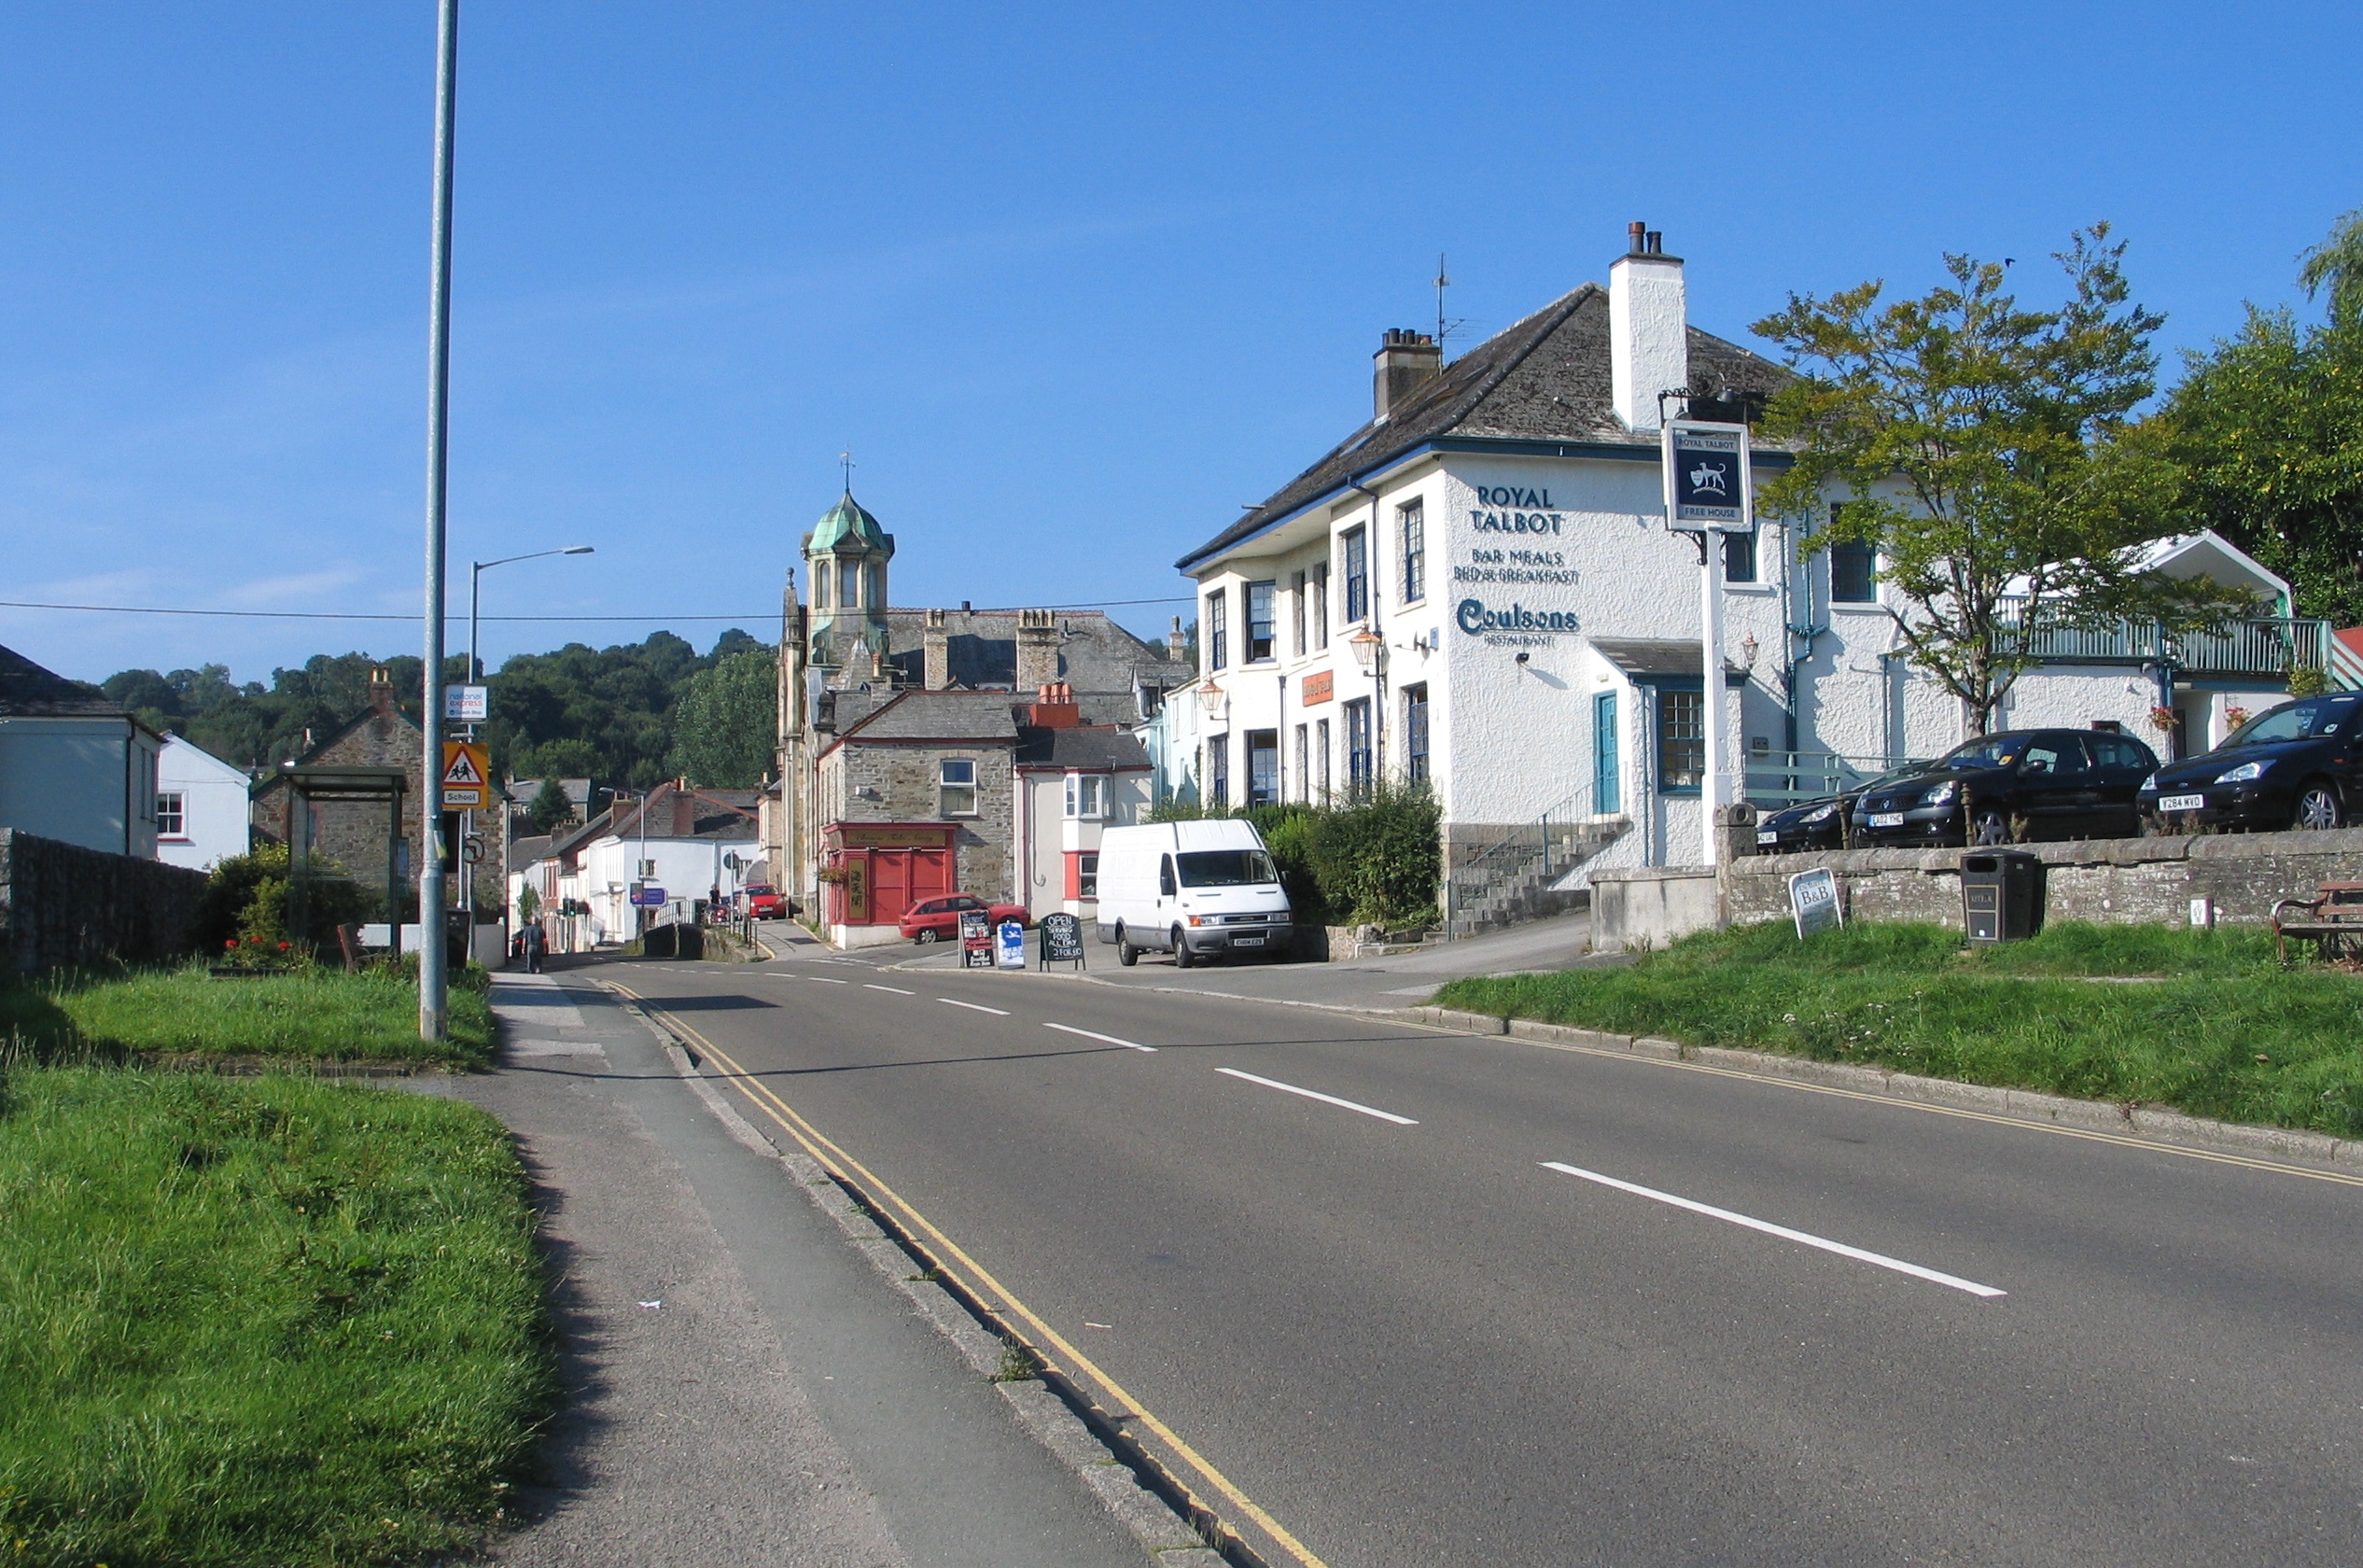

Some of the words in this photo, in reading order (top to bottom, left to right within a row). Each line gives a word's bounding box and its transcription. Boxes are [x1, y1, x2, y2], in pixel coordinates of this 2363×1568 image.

[1679, 438, 1703, 447] ROYAL
[1705, 440, 1735, 449] TALBOT
[1477, 485, 1554, 509] ROYAL
[1685, 507, 1706, 516] FREE
[1708, 509, 1736, 518] HOUSE
[1469, 510, 1562, 533] TALBOT
[1472, 549, 1503, 564] BAR
[1509, 550, 1564, 567] MEALS
[1499, 567, 1580, 584] BREAKFAST
[1457, 598, 1578, 636] Coulsons
[1484, 635, 1558, 647] RESTAURANT
[449, 700, 483, 708] express
[448, 792, 477, 802] School
[1801, 886, 1829, 905] B&B
[1047, 915, 1072, 926] OPEN
